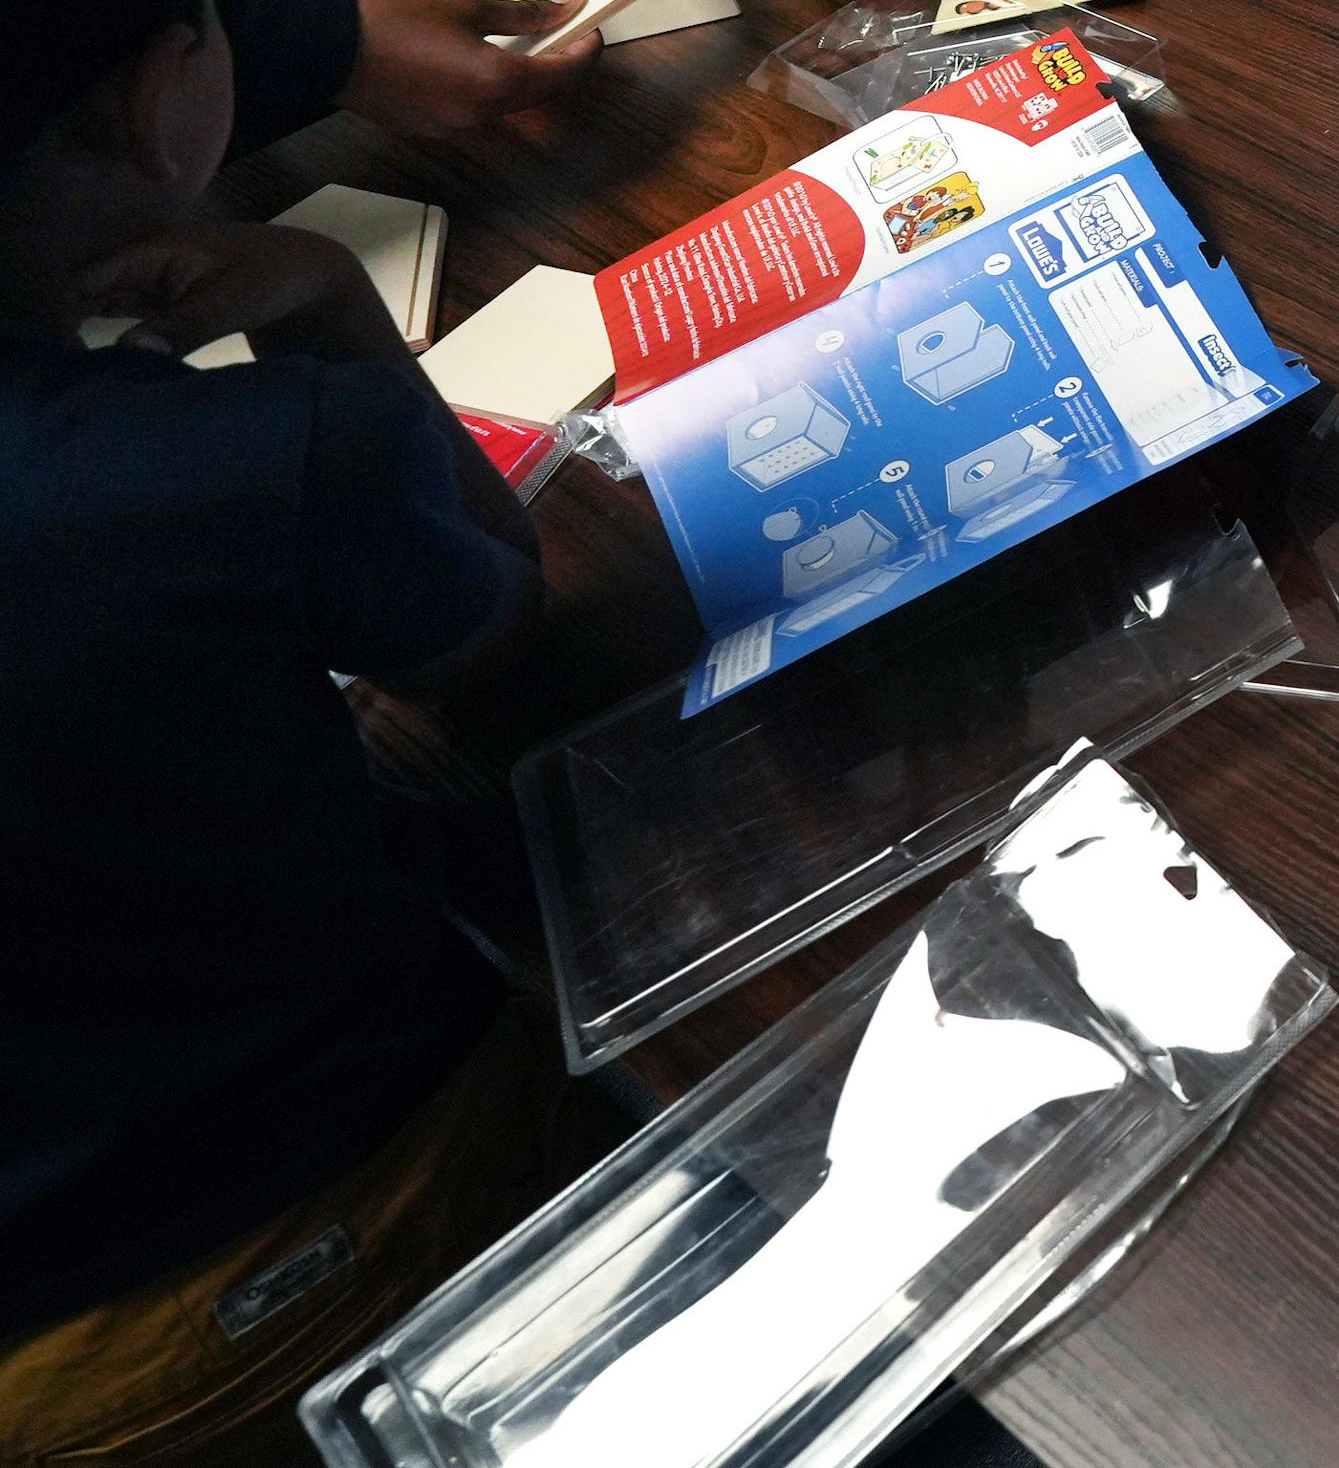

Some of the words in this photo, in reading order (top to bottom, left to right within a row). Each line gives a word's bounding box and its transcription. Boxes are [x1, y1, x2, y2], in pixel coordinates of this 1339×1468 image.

[1036, 57, 1067, 94] GROW
[1050, 44, 1088, 89] BUILD
[1077, 214, 1109, 257] GROW
[1089, 201, 1129, 253] BUILD
[1021, 224, 1062, 278] LOWE'S
[1201, 333, 1231, 372] Insect
[1058, 379, 1076, 395] 2
[885, 463, 904, 479] 5
